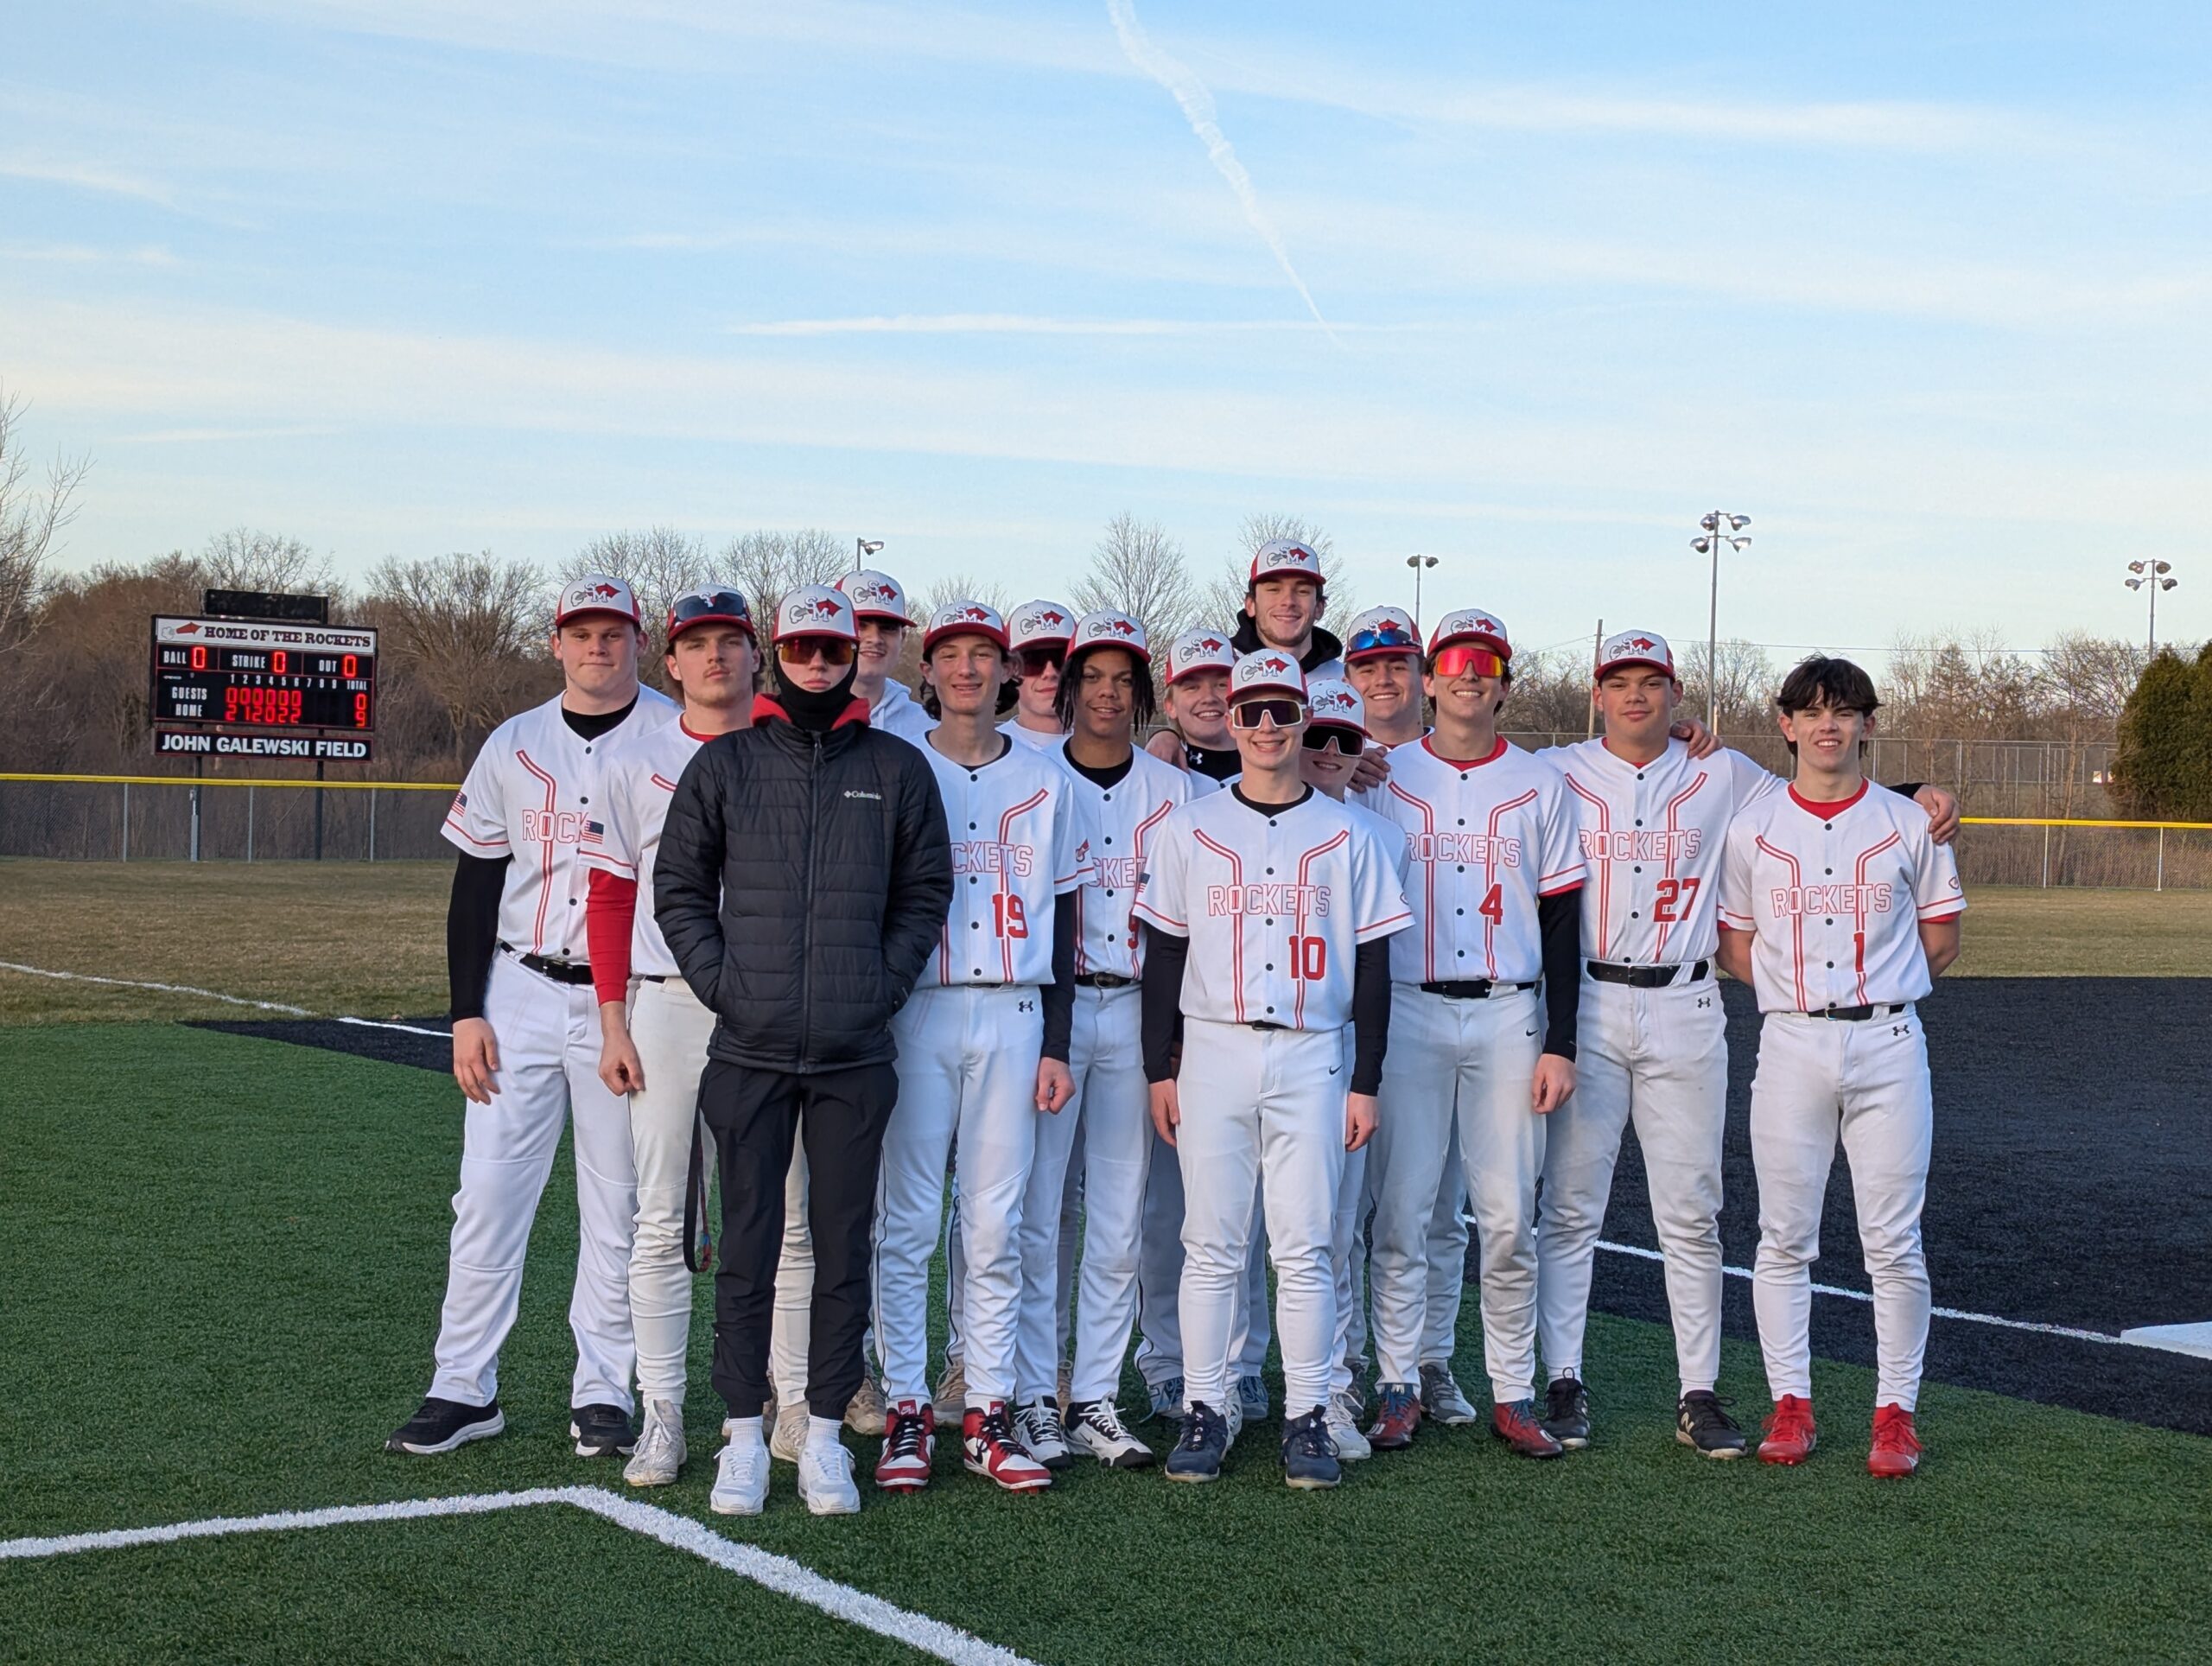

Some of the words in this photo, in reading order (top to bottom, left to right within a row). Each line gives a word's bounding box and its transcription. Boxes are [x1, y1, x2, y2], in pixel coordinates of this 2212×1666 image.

[205, 626, 247, 639] HOME
[251, 629, 270, 641] OF
[271, 630, 302, 643] THE
[305, 633, 371, 647] ROCKETS
[163, 651, 187, 664] BALL
[193, 646, 206, 669] 0
[232, 654, 265, 669] STRIKE
[274, 652, 286, 673] 0
[319, 659, 337, 672] OUT
[344, 655, 357, 677] 0
[172, 686, 207, 700] GUESTS
[356, 693, 366, 710] 0
[231, 674, 235, 684] 1
[243, 674, 248, 684] 2
[256, 675, 261, 684] 3
[269, 676, 274, 685] 4
[282, 677, 286, 686] 5
[294, 677, 299, 687] 6
[307, 678, 311, 688] 7
[319, 678, 324, 689] 8
[332, 679, 337, 689] 9
[346, 680, 367, 690] TOTAL
[175, 703, 202, 717] HOME
[356, 710, 365, 728] 9
[162, 734, 211, 752] JOHN
[216, 737, 309, 756] GALEWSKI
[315, 741, 366, 758] FIELD
[522, 809, 588, 843] ROCK
[950, 841, 1033, 877] CKETS
[1406, 832, 1521, 868] ROCKETS
[1579, 829, 1701, 861] ROCKETS
[993, 893, 1028, 938] 19
[1208, 884, 1331, 917] ROCKETS
[1478, 883, 1503, 925] 4
[1653, 877, 1700, 922] 27
[1771, 882, 1891, 919] ROCKETS
[1289, 935, 1326, 981] 10
[1853, 932, 1865, 972] 1
